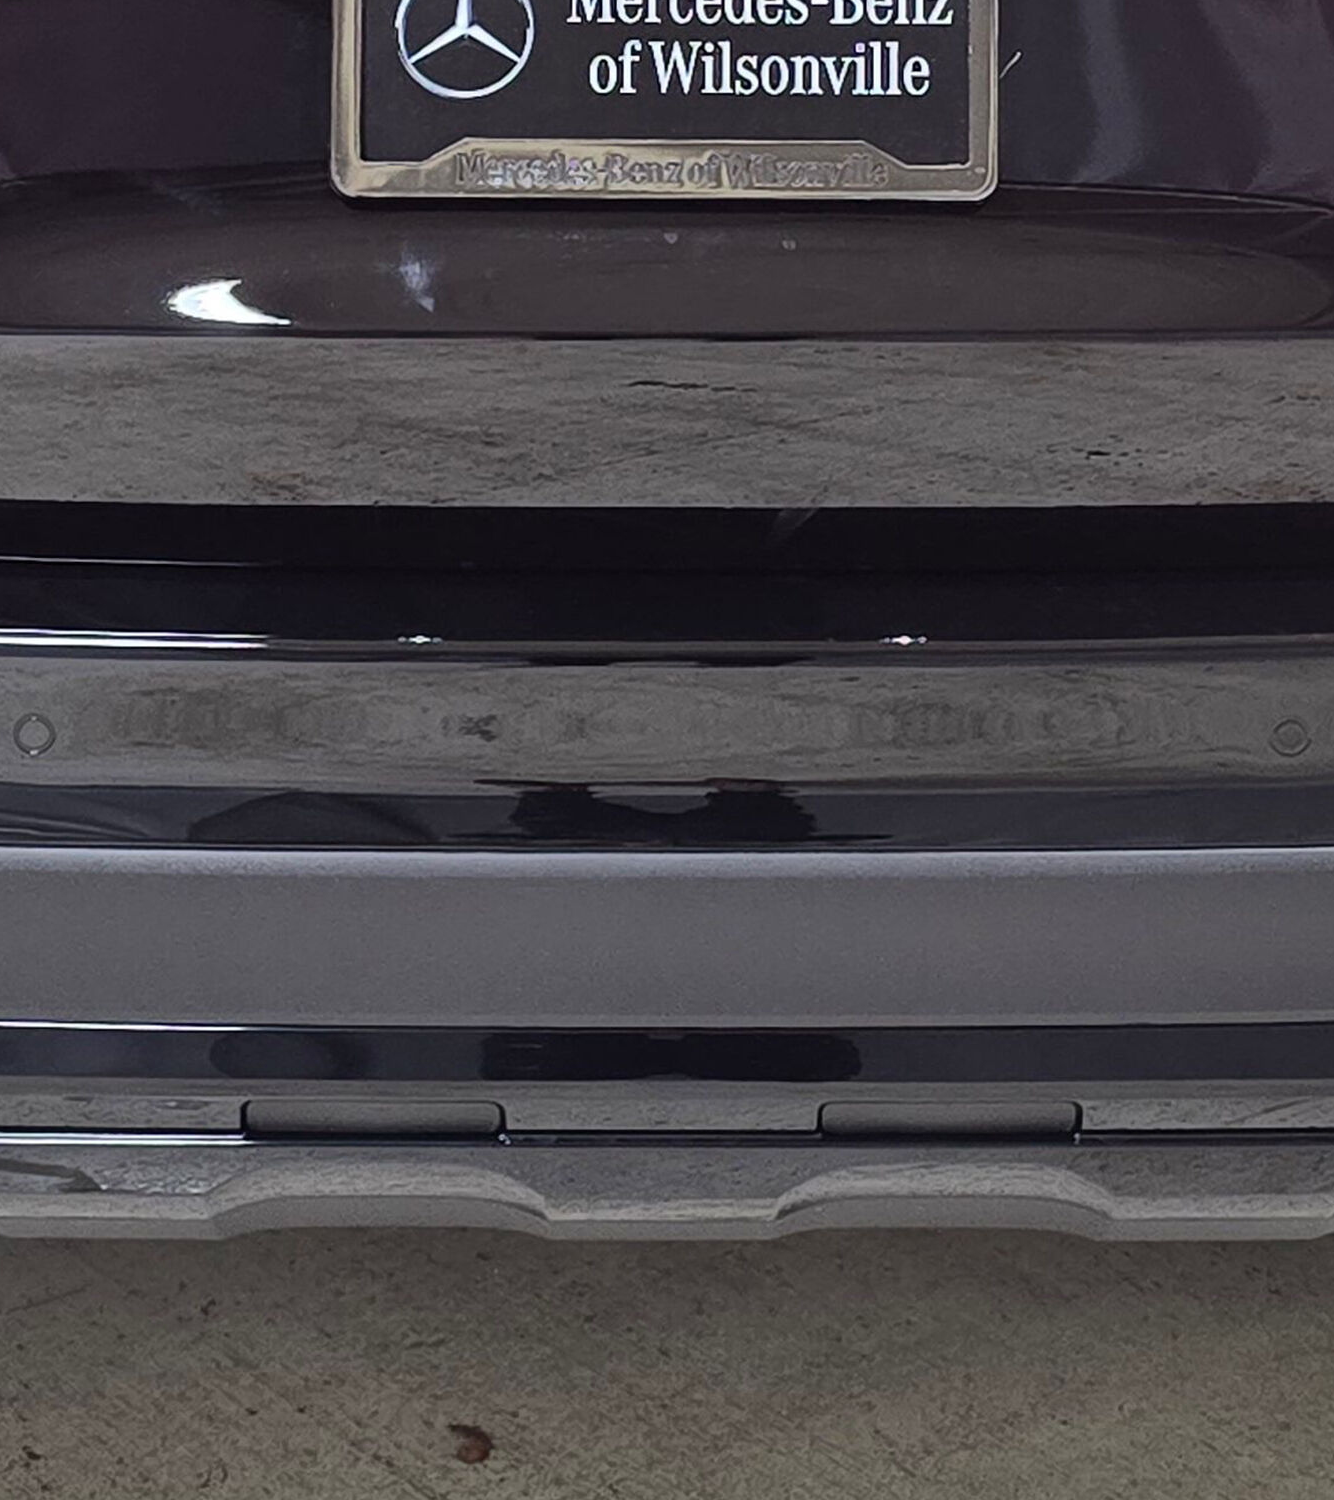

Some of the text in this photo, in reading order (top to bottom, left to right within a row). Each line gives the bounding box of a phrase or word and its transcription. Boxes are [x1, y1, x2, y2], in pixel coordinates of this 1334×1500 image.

[588, 41, 930, 96] of Wilsonville
[455, 150, 684, 188] Mercedes-Benz
